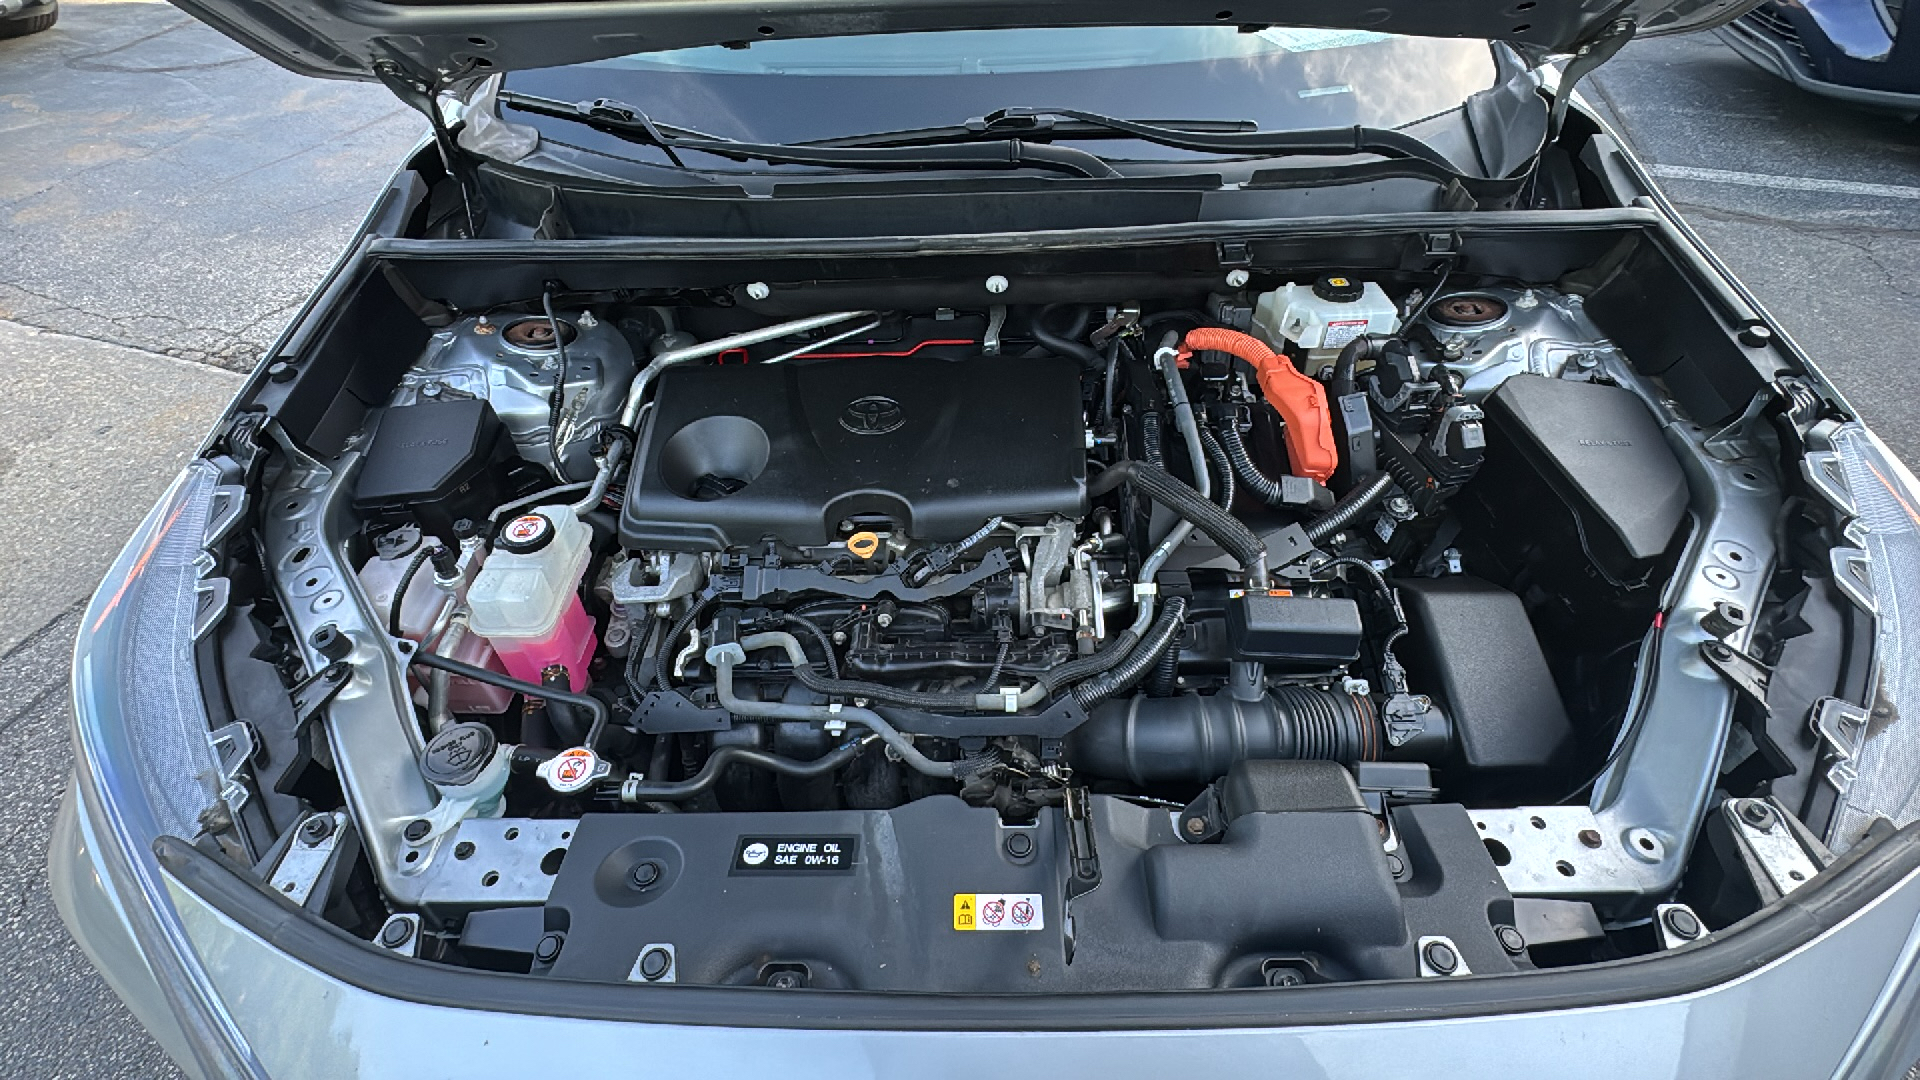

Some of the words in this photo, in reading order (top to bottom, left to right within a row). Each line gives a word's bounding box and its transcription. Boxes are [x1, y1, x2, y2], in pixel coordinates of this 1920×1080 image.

[776, 843, 818, 853] ENGINE
[823, 843, 842, 853] OIL
[773, 854, 798, 865] SAE
[804, 855, 840, 865] 0W-16
